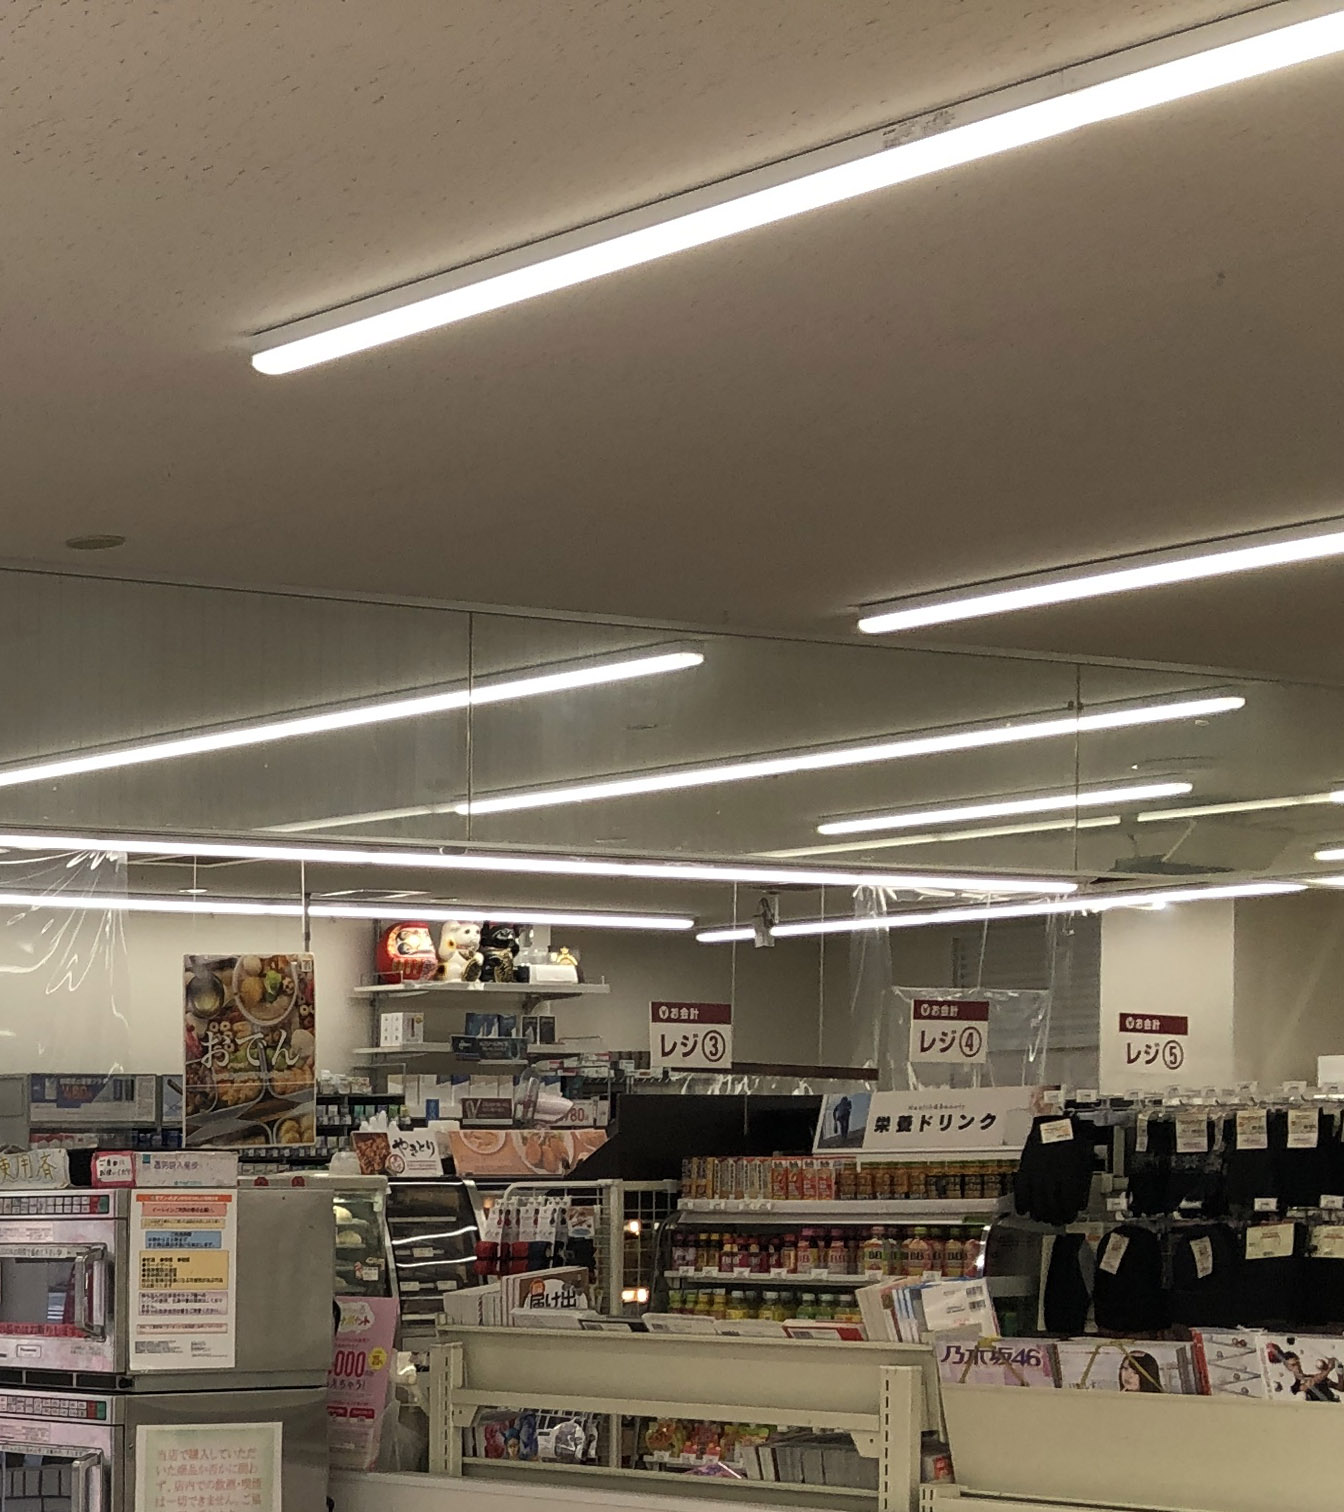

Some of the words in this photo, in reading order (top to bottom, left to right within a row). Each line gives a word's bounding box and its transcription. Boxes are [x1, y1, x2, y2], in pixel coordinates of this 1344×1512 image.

[200, 1031, 300, 1067] おでん
[874, 1113, 996, 1133] 栄養ドリンク
[392, 1137, 435, 1156] やきとり
[940, 1345, 1042, 1368] 乃木坂46
